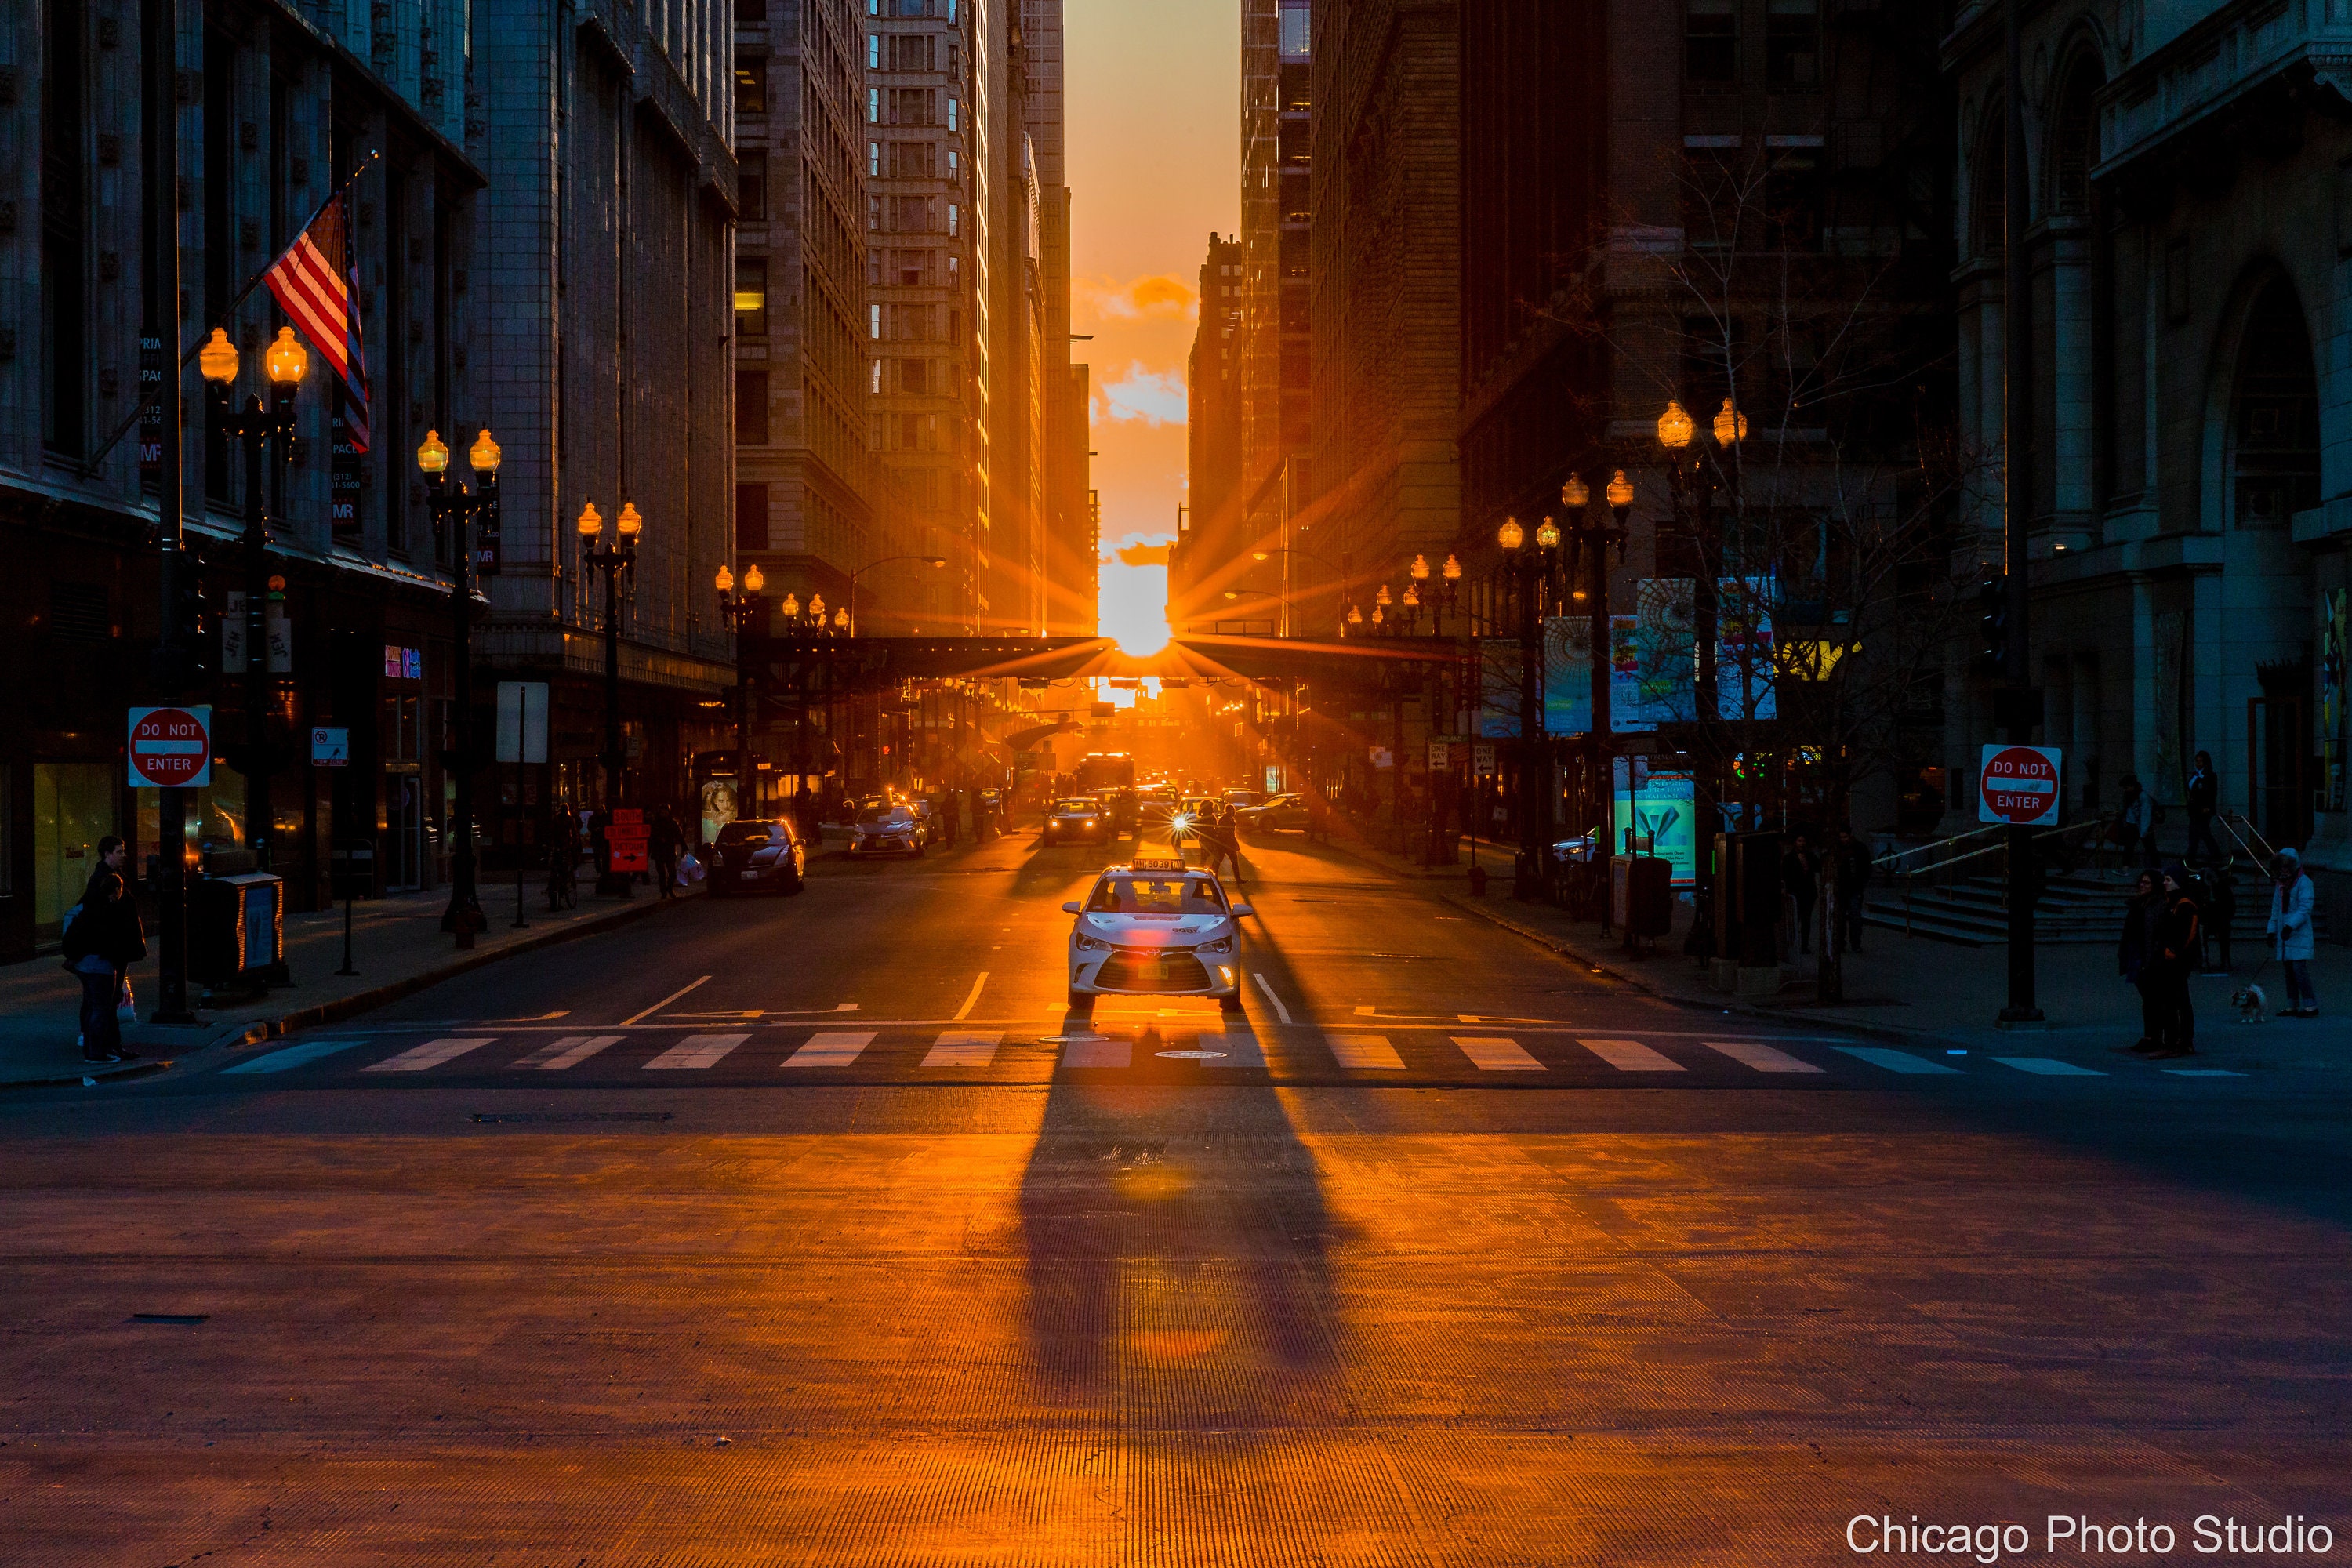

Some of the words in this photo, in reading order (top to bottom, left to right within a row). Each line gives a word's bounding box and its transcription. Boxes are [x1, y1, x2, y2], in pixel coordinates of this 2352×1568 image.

[142, 724, 161, 735] DO
[169, 724, 197, 736] NOT
[147, 758, 191, 770] ENTER
[1994, 761, 2013, 774] DO
[2020, 763, 2048, 775] NOT
[1997, 795, 2041, 808] ENTER
[1148, 860, 1170, 869] 6039
